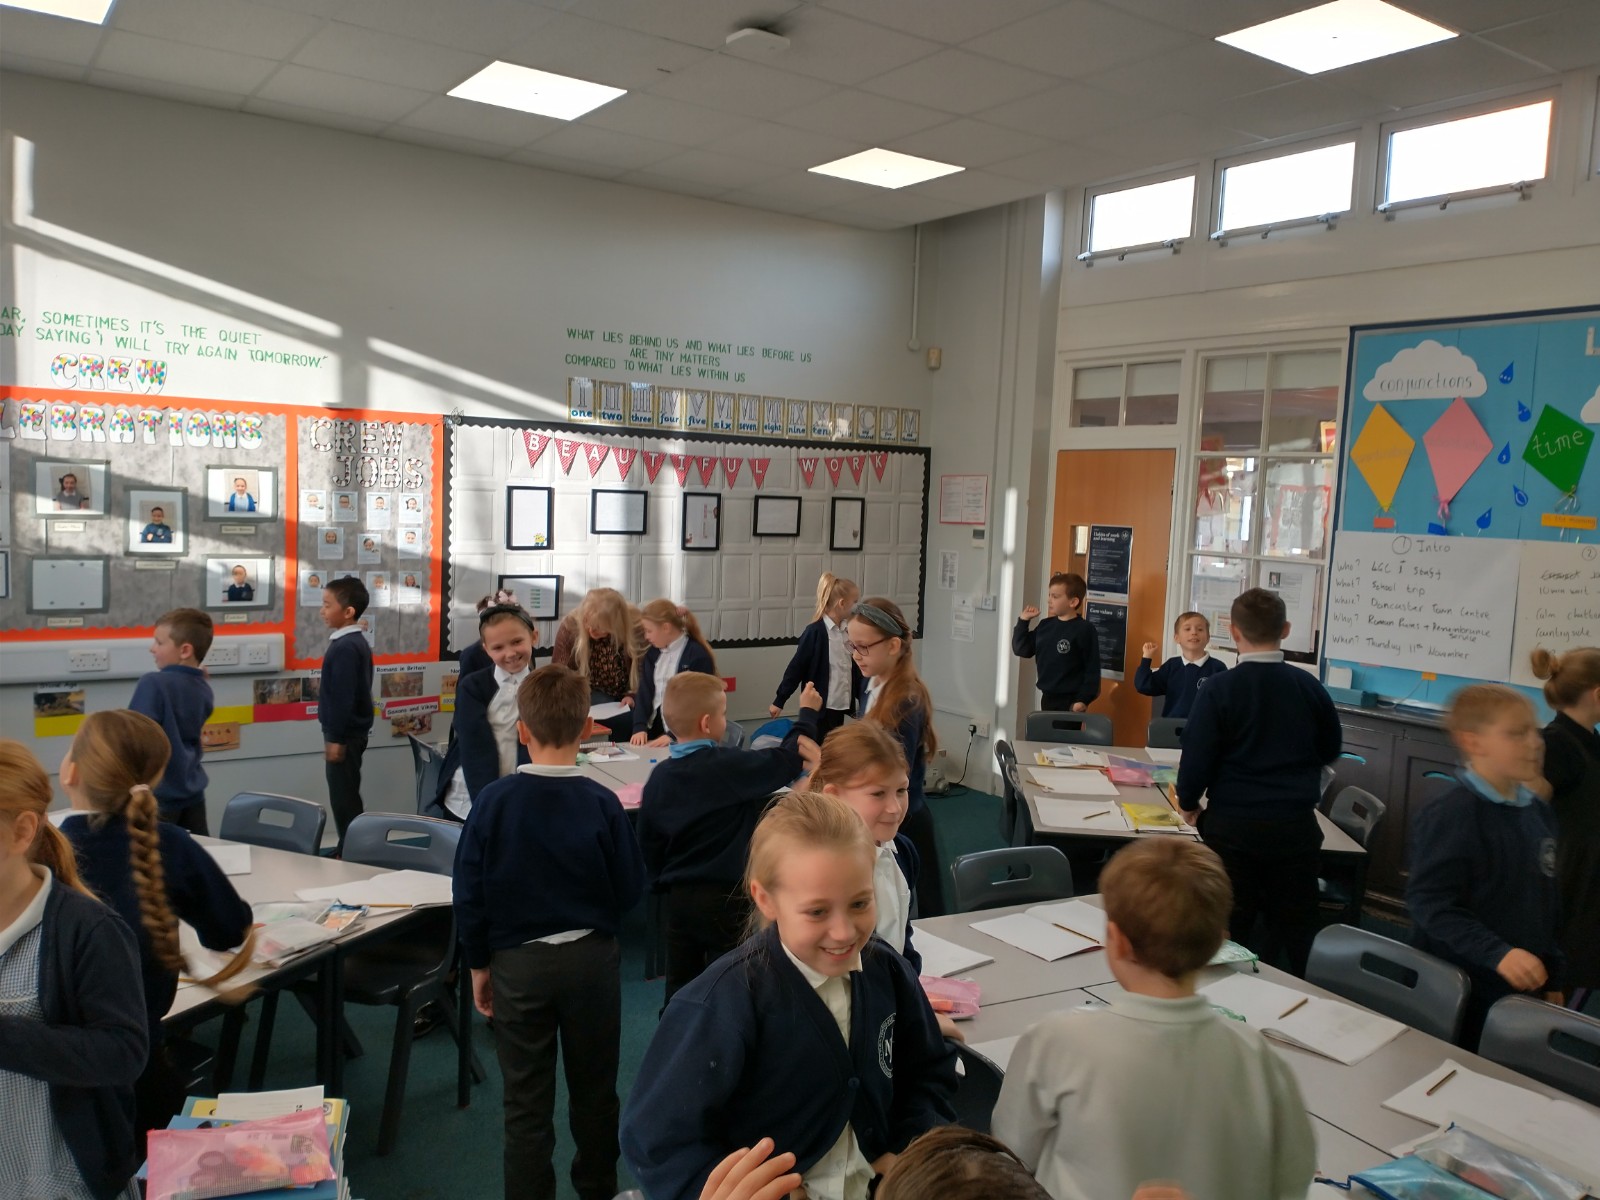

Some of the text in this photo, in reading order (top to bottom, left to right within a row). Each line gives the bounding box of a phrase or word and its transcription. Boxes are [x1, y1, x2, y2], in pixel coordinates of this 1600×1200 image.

[42, 311, 130, 331] SOMETIMES
[140, 320, 165, 335] IT'S
[181, 324, 207, 339] THE
[219, 329, 262, 345] QUIET
[36, 327, 91, 345] SAYING
[115, 336, 151, 351] WILL
[165, 341, 190, 356] TRY
[197, 344, 238, 361] AGAIN
[566, 327, 812, 363] WHAT LIES BEHIND US AND WHAT LIES BEFORE US
[565, 353, 746, 383] COMPARED TO WHAT LIES WITHIN US
[630, 348, 720, 367] ARE TINY MATTERS
[51, 353, 167, 394] CREW
[1380, 372, 1472, 398] conjunctions
[571, 409, 593, 418] one
[602, 411, 622, 420] two
[631, 414, 652, 423] three
[660, 414, 679, 424] four
[687, 416, 706, 426] five
[713, 420, 731, 430] six
[740, 422, 757, 431] seven
[764, 423, 781, 433] eight
[788, 426, 805, 434] nine
[813, 426, 829, 436] ten
[310, 420, 404, 455] CREW
[1532, 429, 1585, 459] time
[528, 434, 884, 475] BEAUTIFUL WORK
[332, 456, 424, 489] JOBS
[1416, 540, 1451, 553] Intro
[1337, 558, 1360, 572] Who?
[1335, 576, 1360, 588] What?
[1406, 584, 1426, 598] trip
[1371, 597, 1424, 612] Doncaster
[1432, 603, 1453, 614] Town
[1460, 607, 1490, 619] Centre
[1334, 611, 1359, 628] Why?
[1368, 614, 1395, 626] Roman
[1432, 621, 1491, 637] Remembrance
[1332, 634, 1360, 646] When?
[1366, 637, 1401, 656] Thursday
[1428, 644, 1470, 660] November
